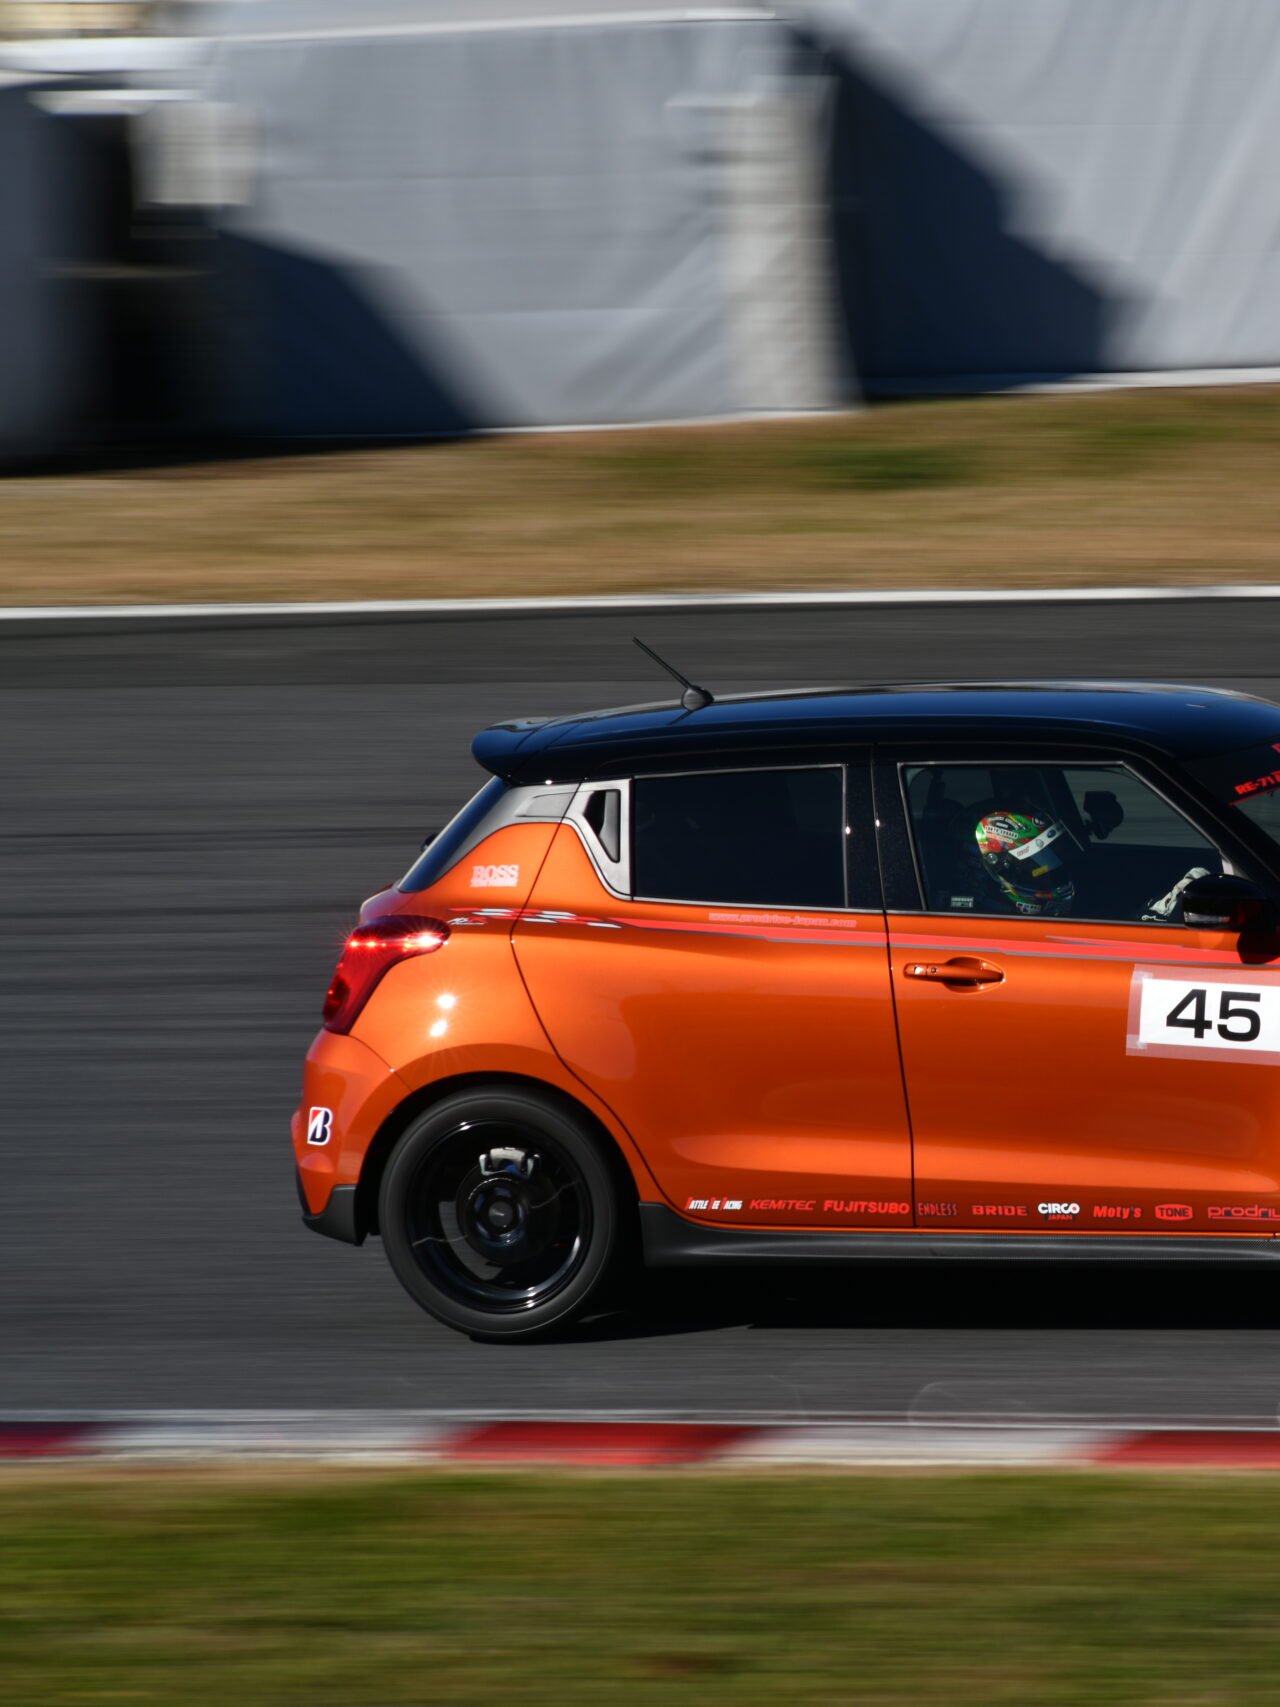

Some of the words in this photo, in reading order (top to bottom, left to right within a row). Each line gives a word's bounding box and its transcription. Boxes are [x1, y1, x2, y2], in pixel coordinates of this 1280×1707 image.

[1166, 988, 1261, 1042] 45
[823, 1200, 911, 1215] FUJITSUBO
[917, 1202, 957, 1216] ENDLESS
[971, 1204, 1028, 1216] BRIDE
[1037, 1202, 1081, 1215] CIRCO
[1093, 1205, 1142, 1219] Moty's
